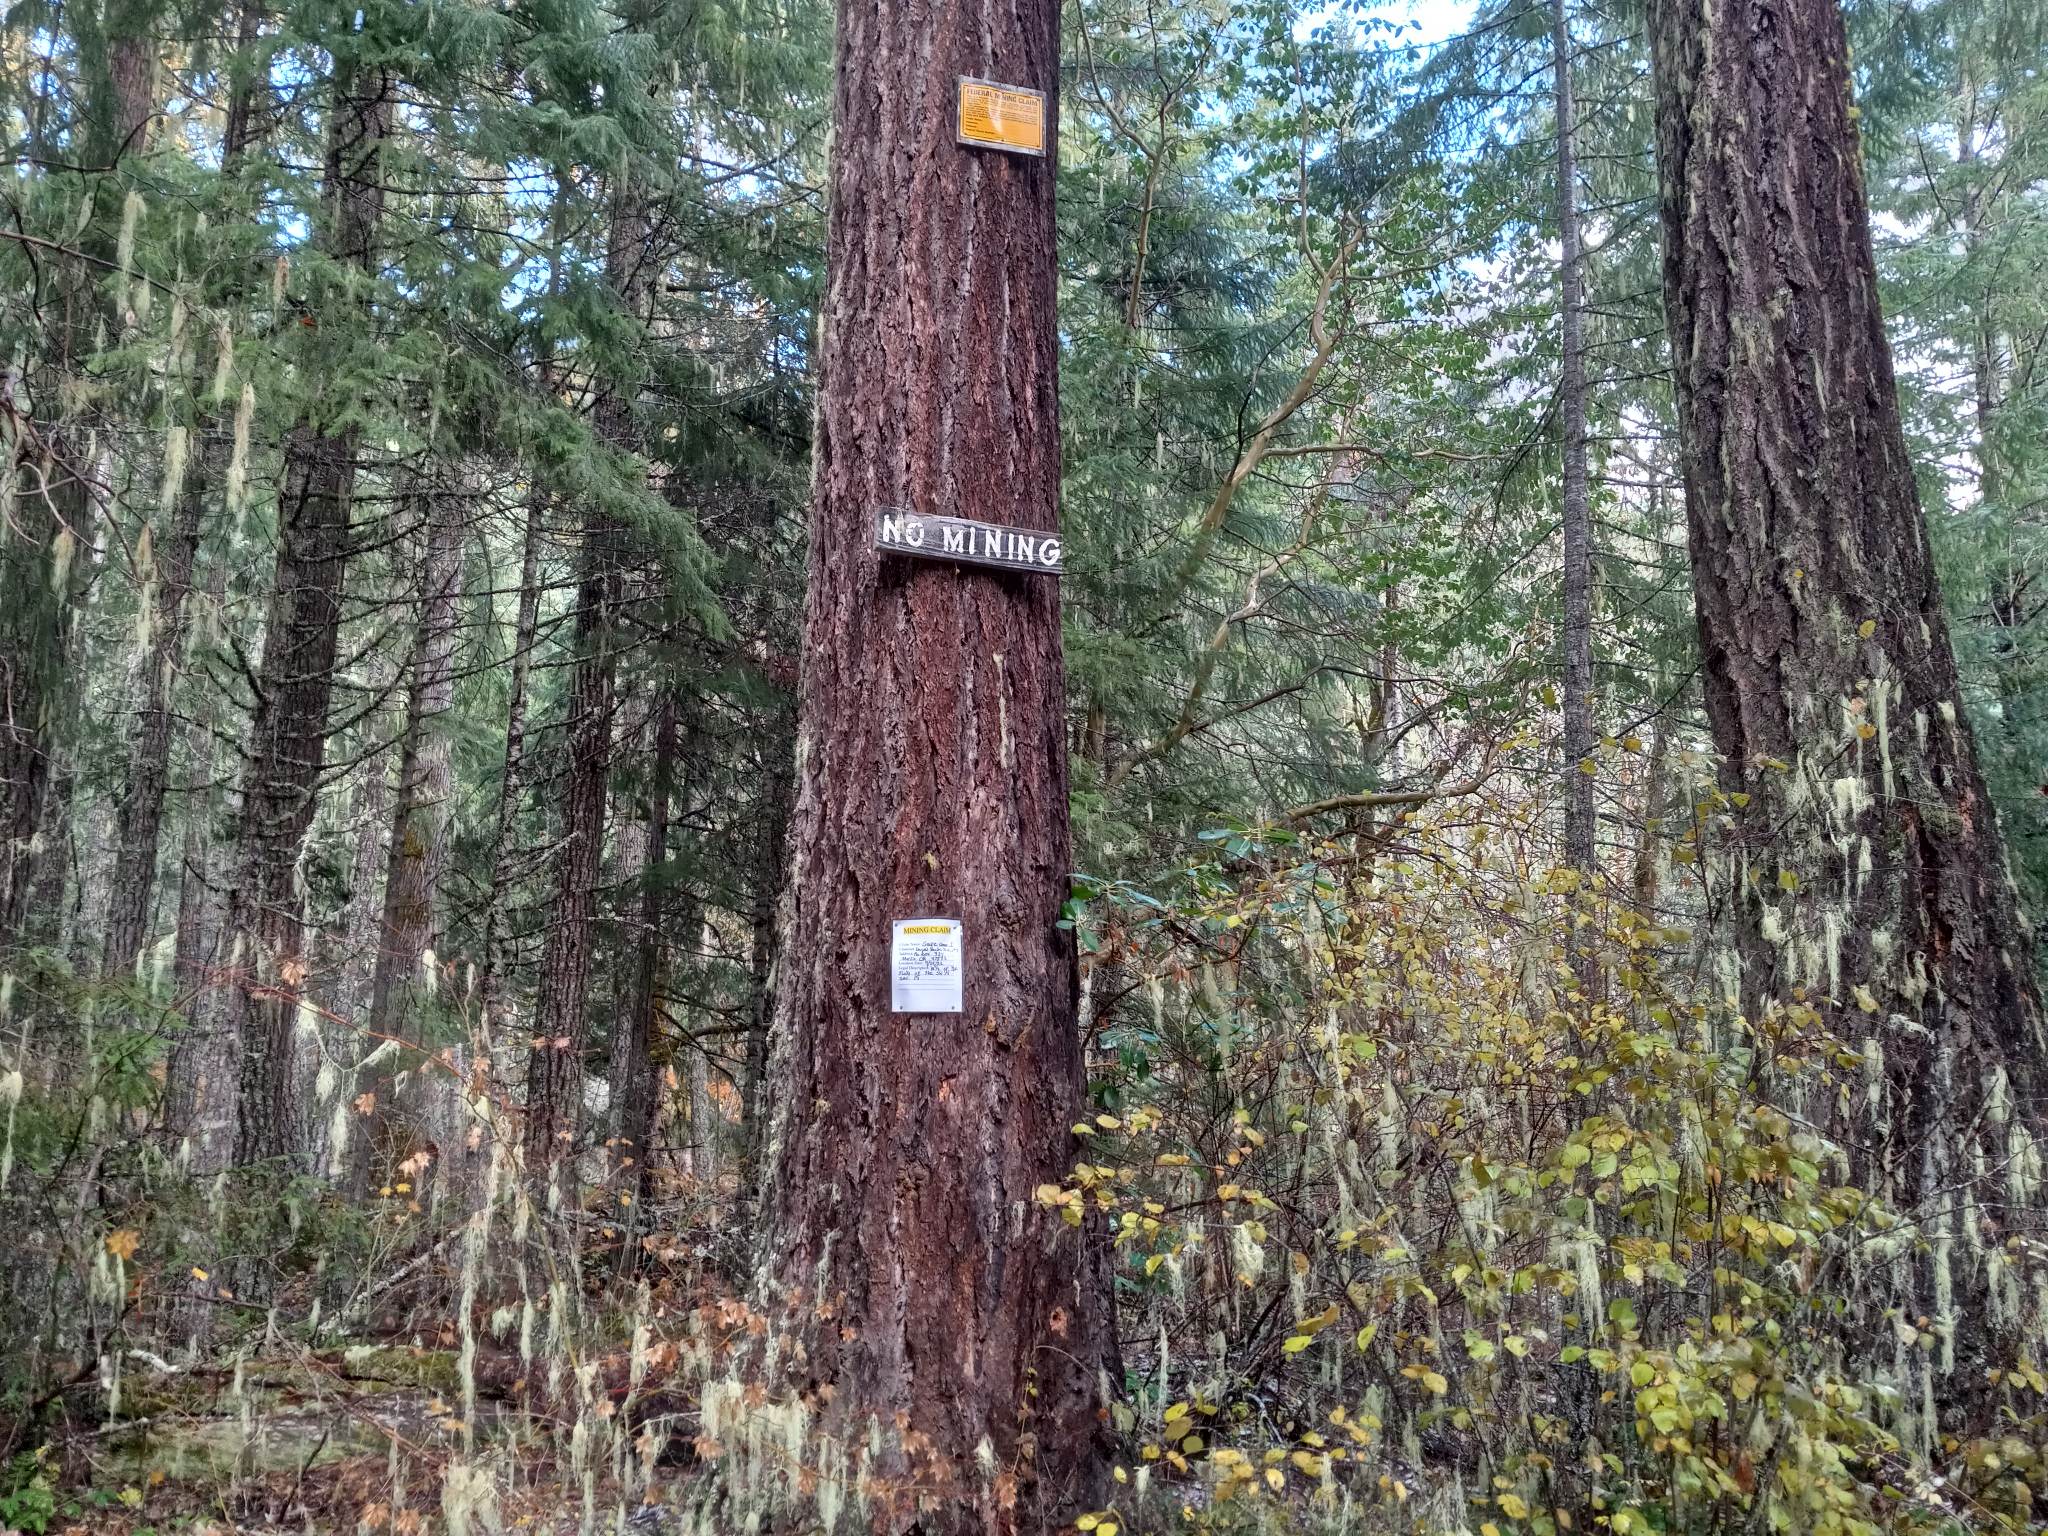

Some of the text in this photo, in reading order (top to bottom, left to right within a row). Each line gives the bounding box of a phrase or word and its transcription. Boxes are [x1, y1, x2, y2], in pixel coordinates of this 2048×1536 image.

[966, 88, 1038, 107] FEDERAL MNING CLAIM
[882, 514, 1061, 566] NO MINING
[903, 926, 951, 935] MINING CLAIM
